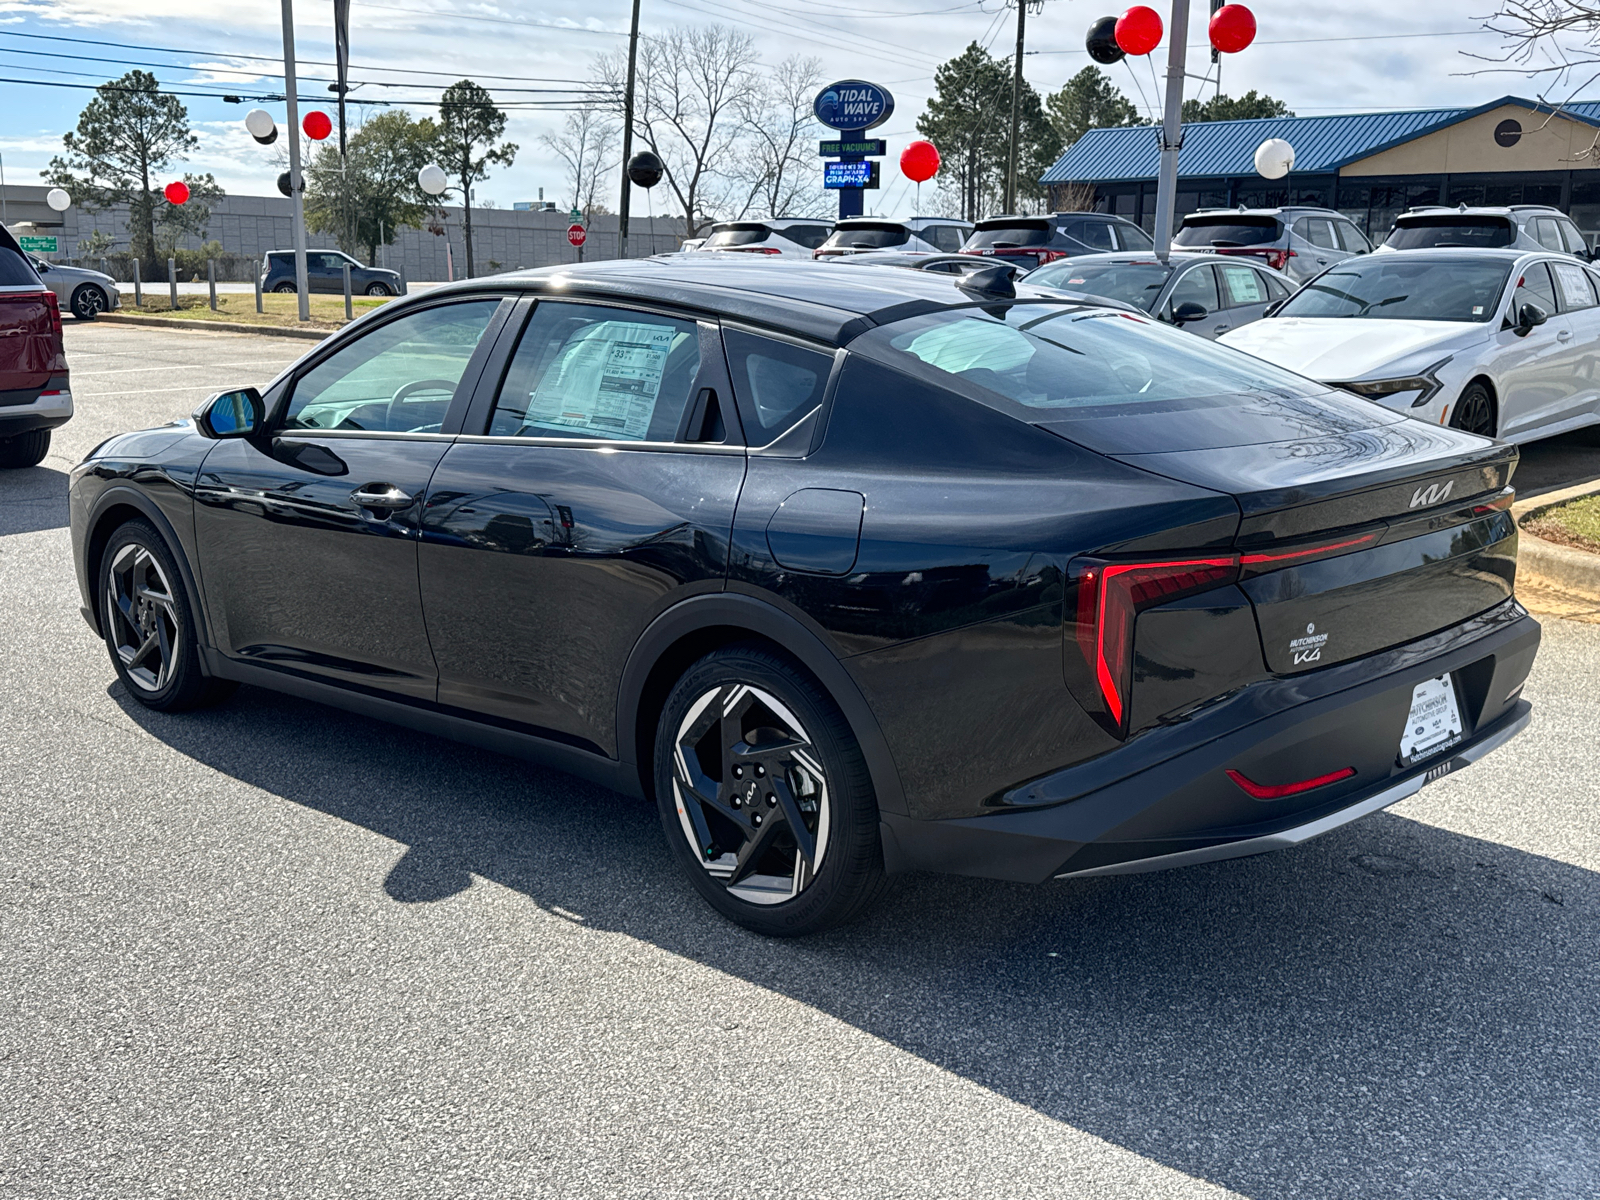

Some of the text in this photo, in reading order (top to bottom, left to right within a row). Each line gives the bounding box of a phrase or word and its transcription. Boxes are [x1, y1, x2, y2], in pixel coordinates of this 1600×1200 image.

[839, 90, 872, 102] TIDAL
[844, 103, 880, 115] WAVE
[822, 142, 876, 153] FREE VACUUMS
[568, 231, 586, 240] STOP
[614, 349, 625, 359] 33
[1409, 480, 1454, 508] KIA
[1289, 633, 1329, 648] HUTCHINSON
[1293, 648, 1321, 665] K4
[669, 672, 701, 713] SOLUS
[1409, 693, 1448, 718] HUTCHINSON
[1412, 710, 1436, 725] AUTOMOTIVE
[1436, 704, 1448, 717] GROUP
[745, 782, 757, 805] KIA
[785, 888, 829, 925] KUMHO
